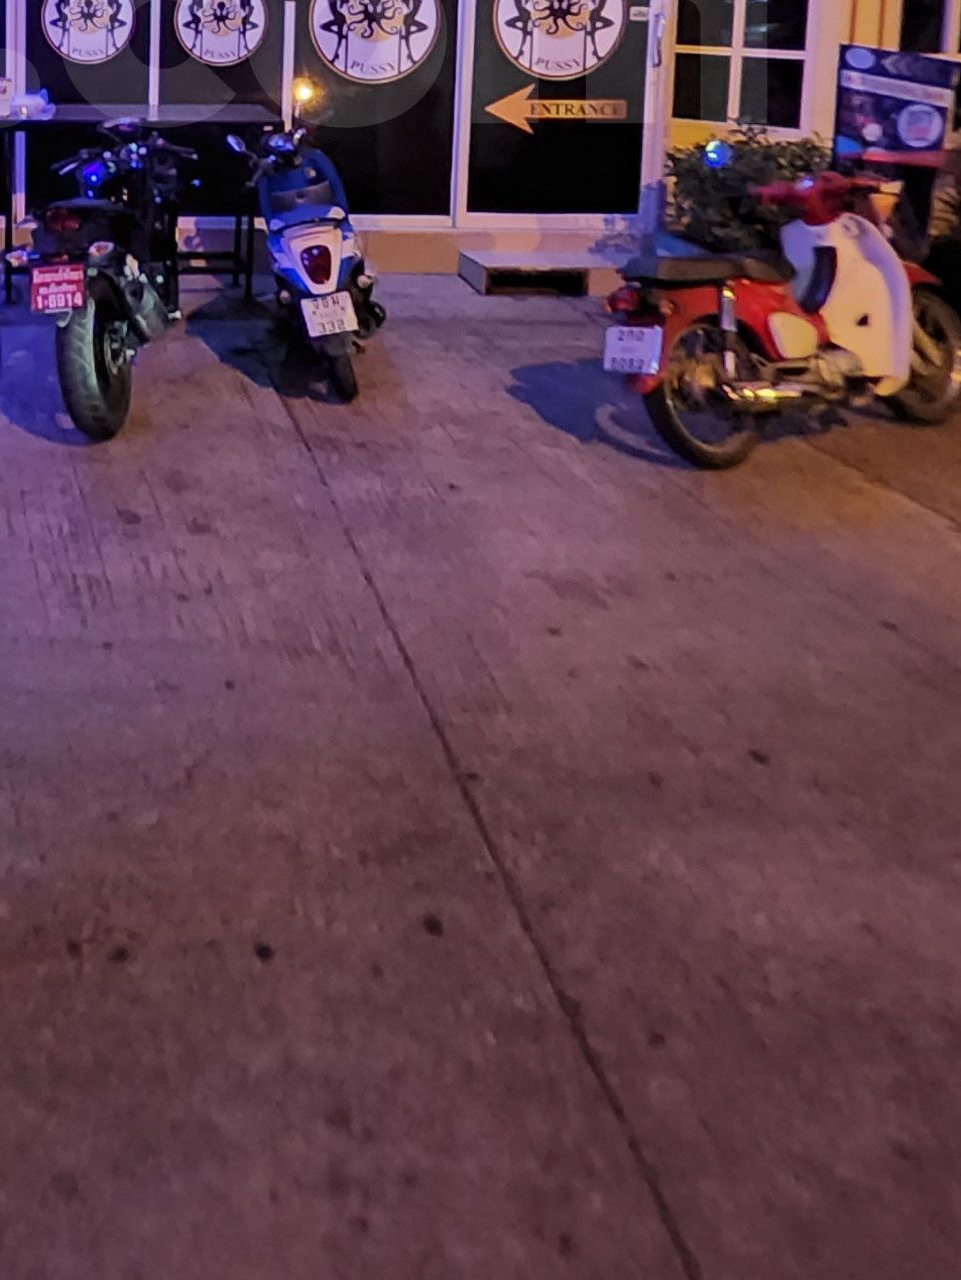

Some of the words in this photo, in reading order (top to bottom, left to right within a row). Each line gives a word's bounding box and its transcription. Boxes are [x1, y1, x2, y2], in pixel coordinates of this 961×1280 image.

[350, 60, 396, 74] PUSSY
[535, 56, 581, 70] PUSSY
[530, 102, 624, 116] ENTRANCE
